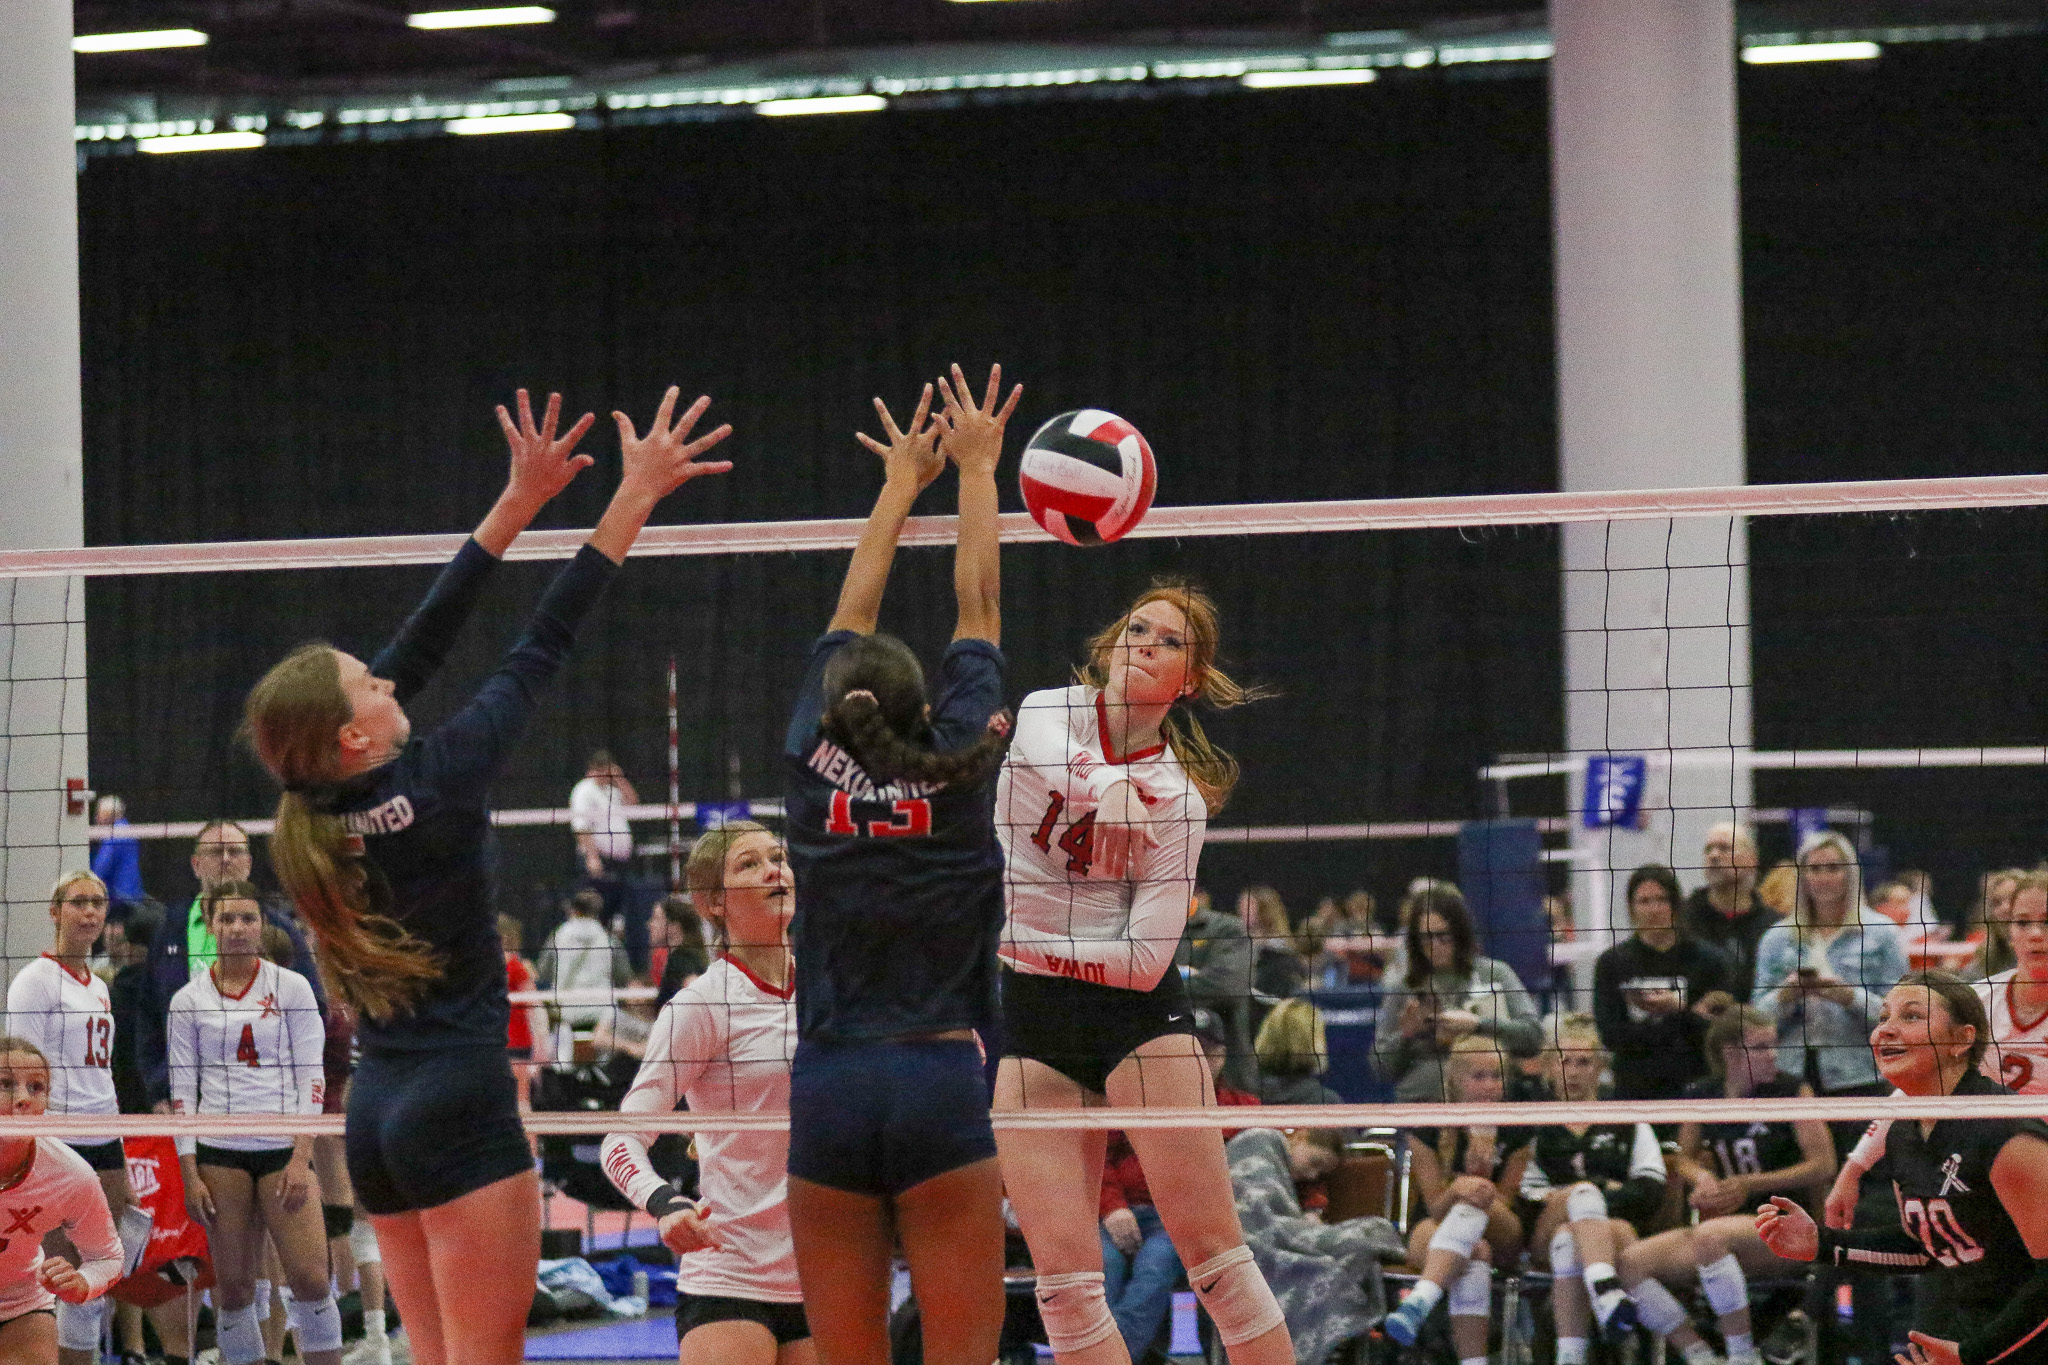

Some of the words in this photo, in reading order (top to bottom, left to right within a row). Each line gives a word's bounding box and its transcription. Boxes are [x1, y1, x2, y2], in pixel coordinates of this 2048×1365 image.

[1030, 789, 1098, 877] 14
[84, 1015, 111, 1068] 13
[236, 1023, 261, 1069] 4
